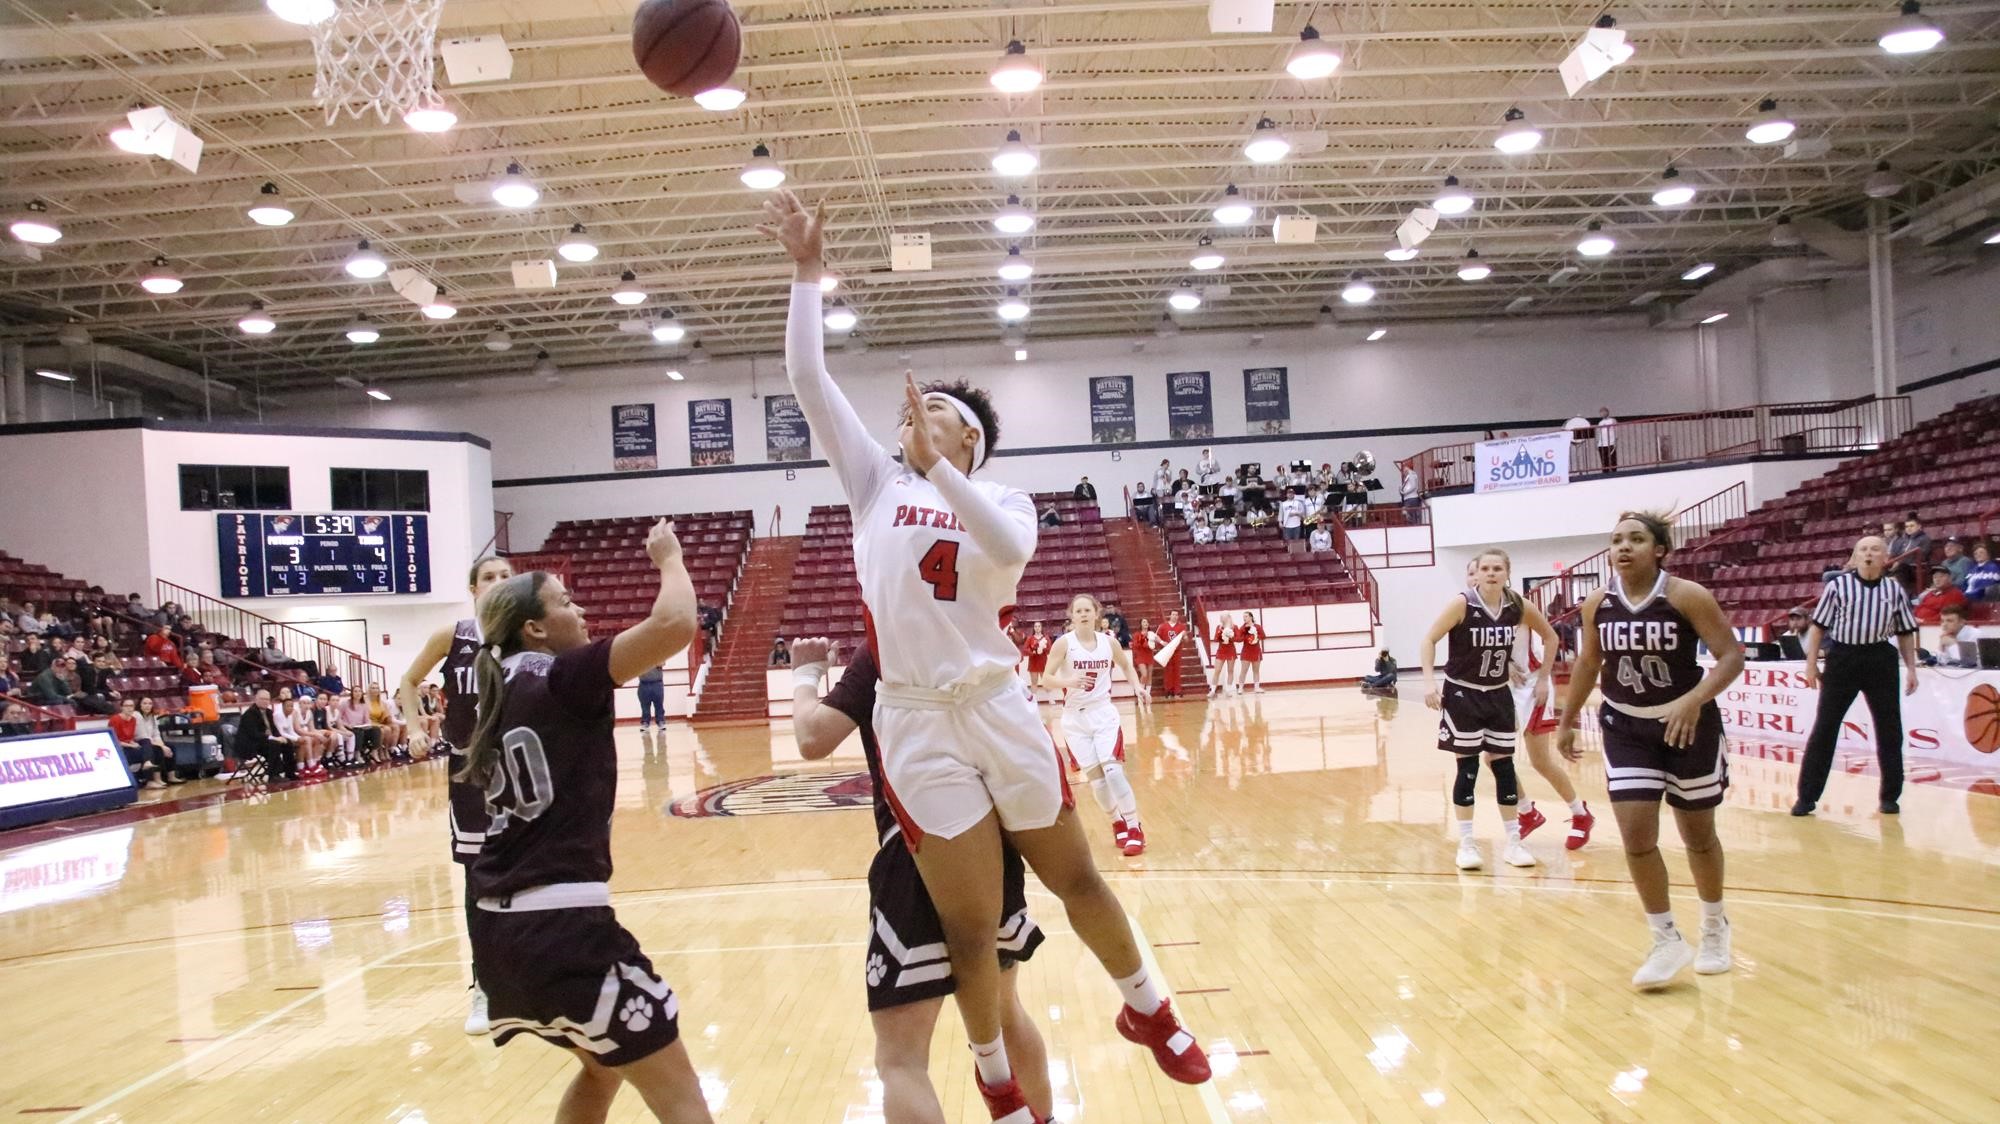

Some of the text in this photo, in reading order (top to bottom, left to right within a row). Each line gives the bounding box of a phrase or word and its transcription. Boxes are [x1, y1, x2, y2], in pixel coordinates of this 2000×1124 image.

[1111, 450, 1122, 461] B
[1491, 449, 1554, 466] U C
[786, 469, 796, 481] B
[1490, 460, 1556, 482] SOUND
[315, 515, 353, 534] 5:39
[236, 514, 249, 596] PATRIOTS
[289, 546, 300, 564] 3
[374, 547, 386, 562] 4
[405, 515, 417, 592] PATRIOTS
[278, 573, 288, 585] 4
[298, 572, 307, 586] 3
[356, 571, 365, 584] 4
[378, 570, 387, 584] 2
[918, 539, 960, 602] 4
[1598, 621, 1678, 651] TIGERS
[1073, 659, 1109, 670] PATRIOTS
[1479, 649, 1507, 678] 13
[1617, 655, 1672, 694] 40
[1727, 690, 1798, 707] OF THE
